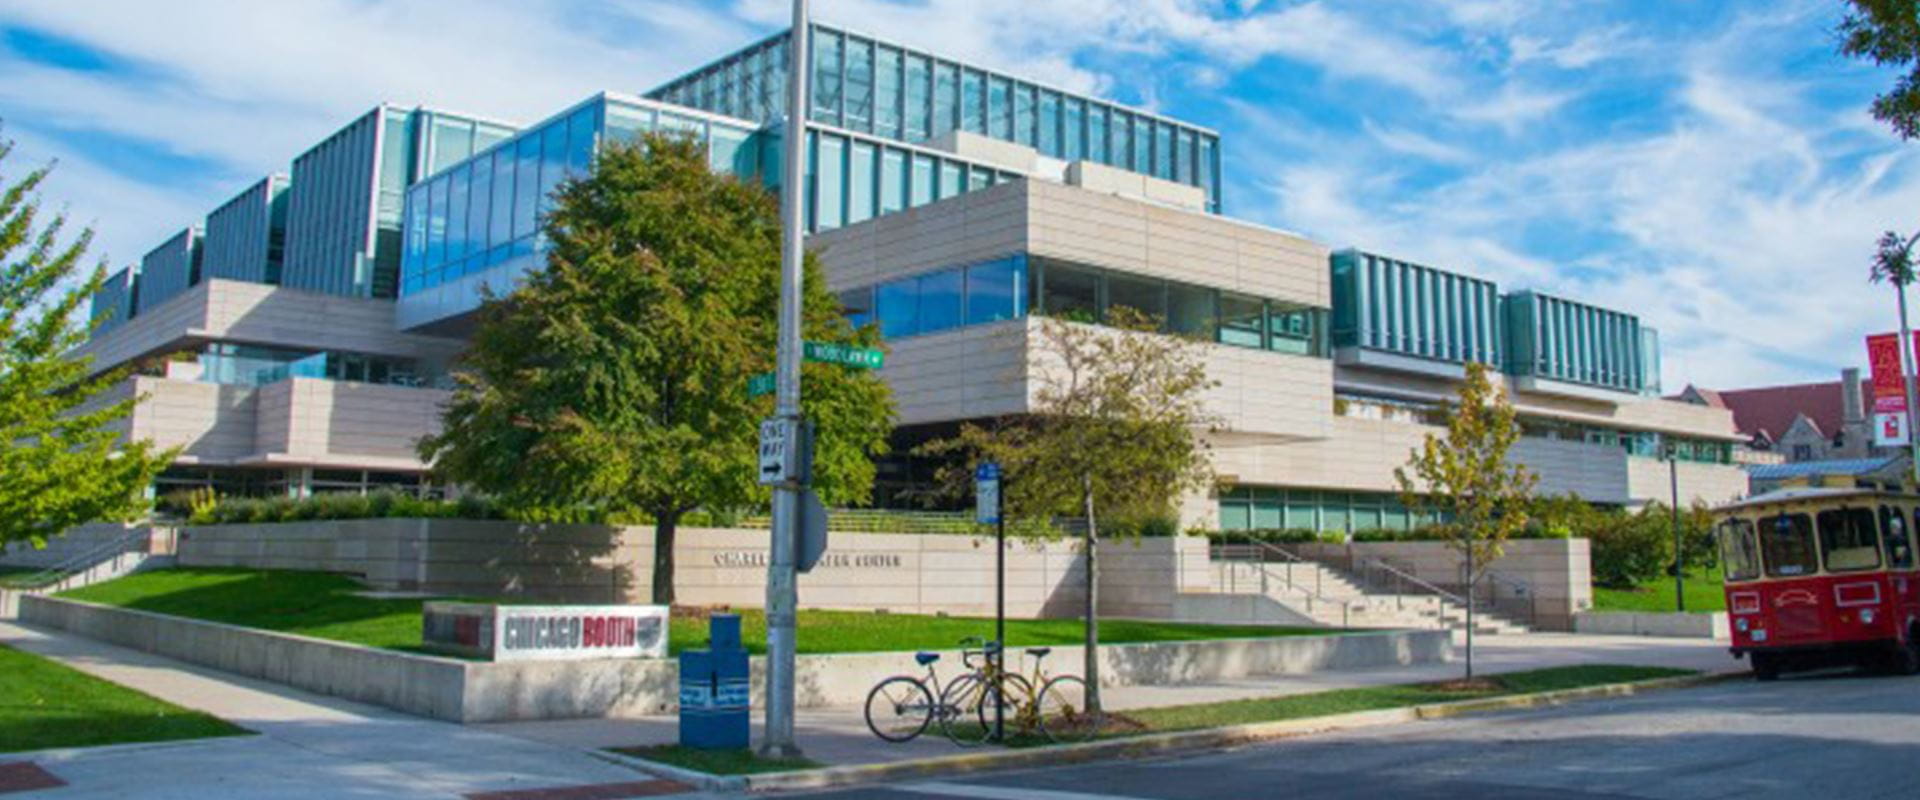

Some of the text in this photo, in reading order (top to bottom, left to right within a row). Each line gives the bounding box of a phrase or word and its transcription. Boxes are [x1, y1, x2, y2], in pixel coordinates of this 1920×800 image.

[762, 422, 784, 439] ONE
[762, 442, 784, 457] WAY
[505, 616, 581, 650] CHICAGO
[582, 615, 635, 647] BOOTH
